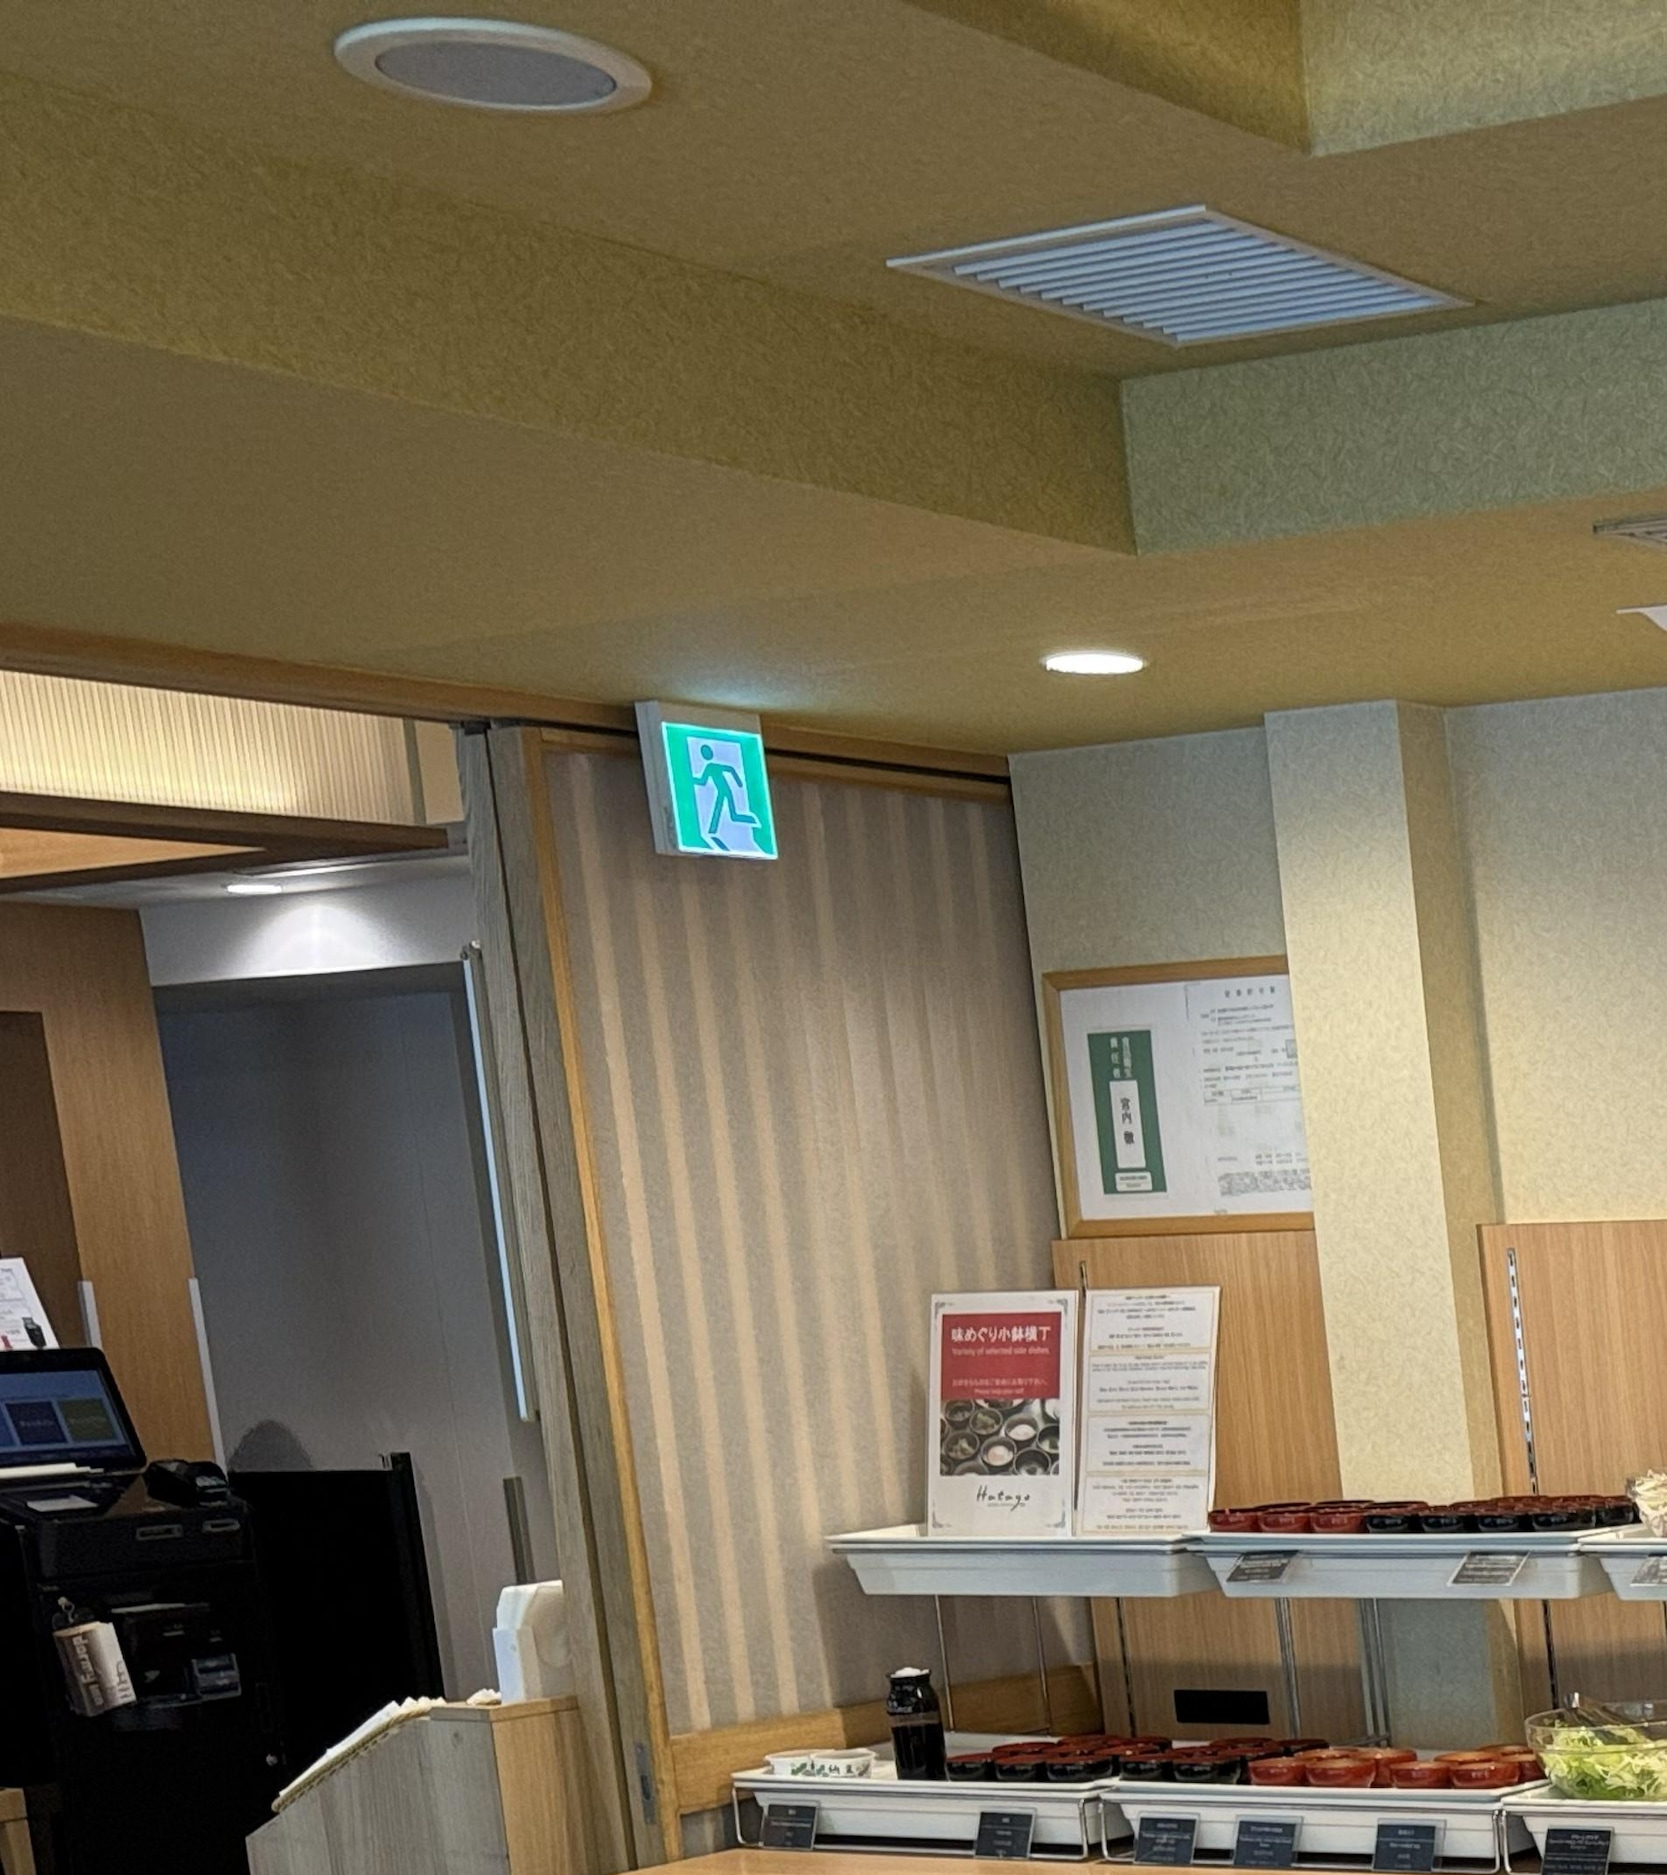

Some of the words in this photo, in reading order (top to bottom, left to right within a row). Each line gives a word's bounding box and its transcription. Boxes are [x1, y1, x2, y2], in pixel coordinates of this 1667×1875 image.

[951, 1325, 1051, 1343] 味めぐり小鉢横丁
